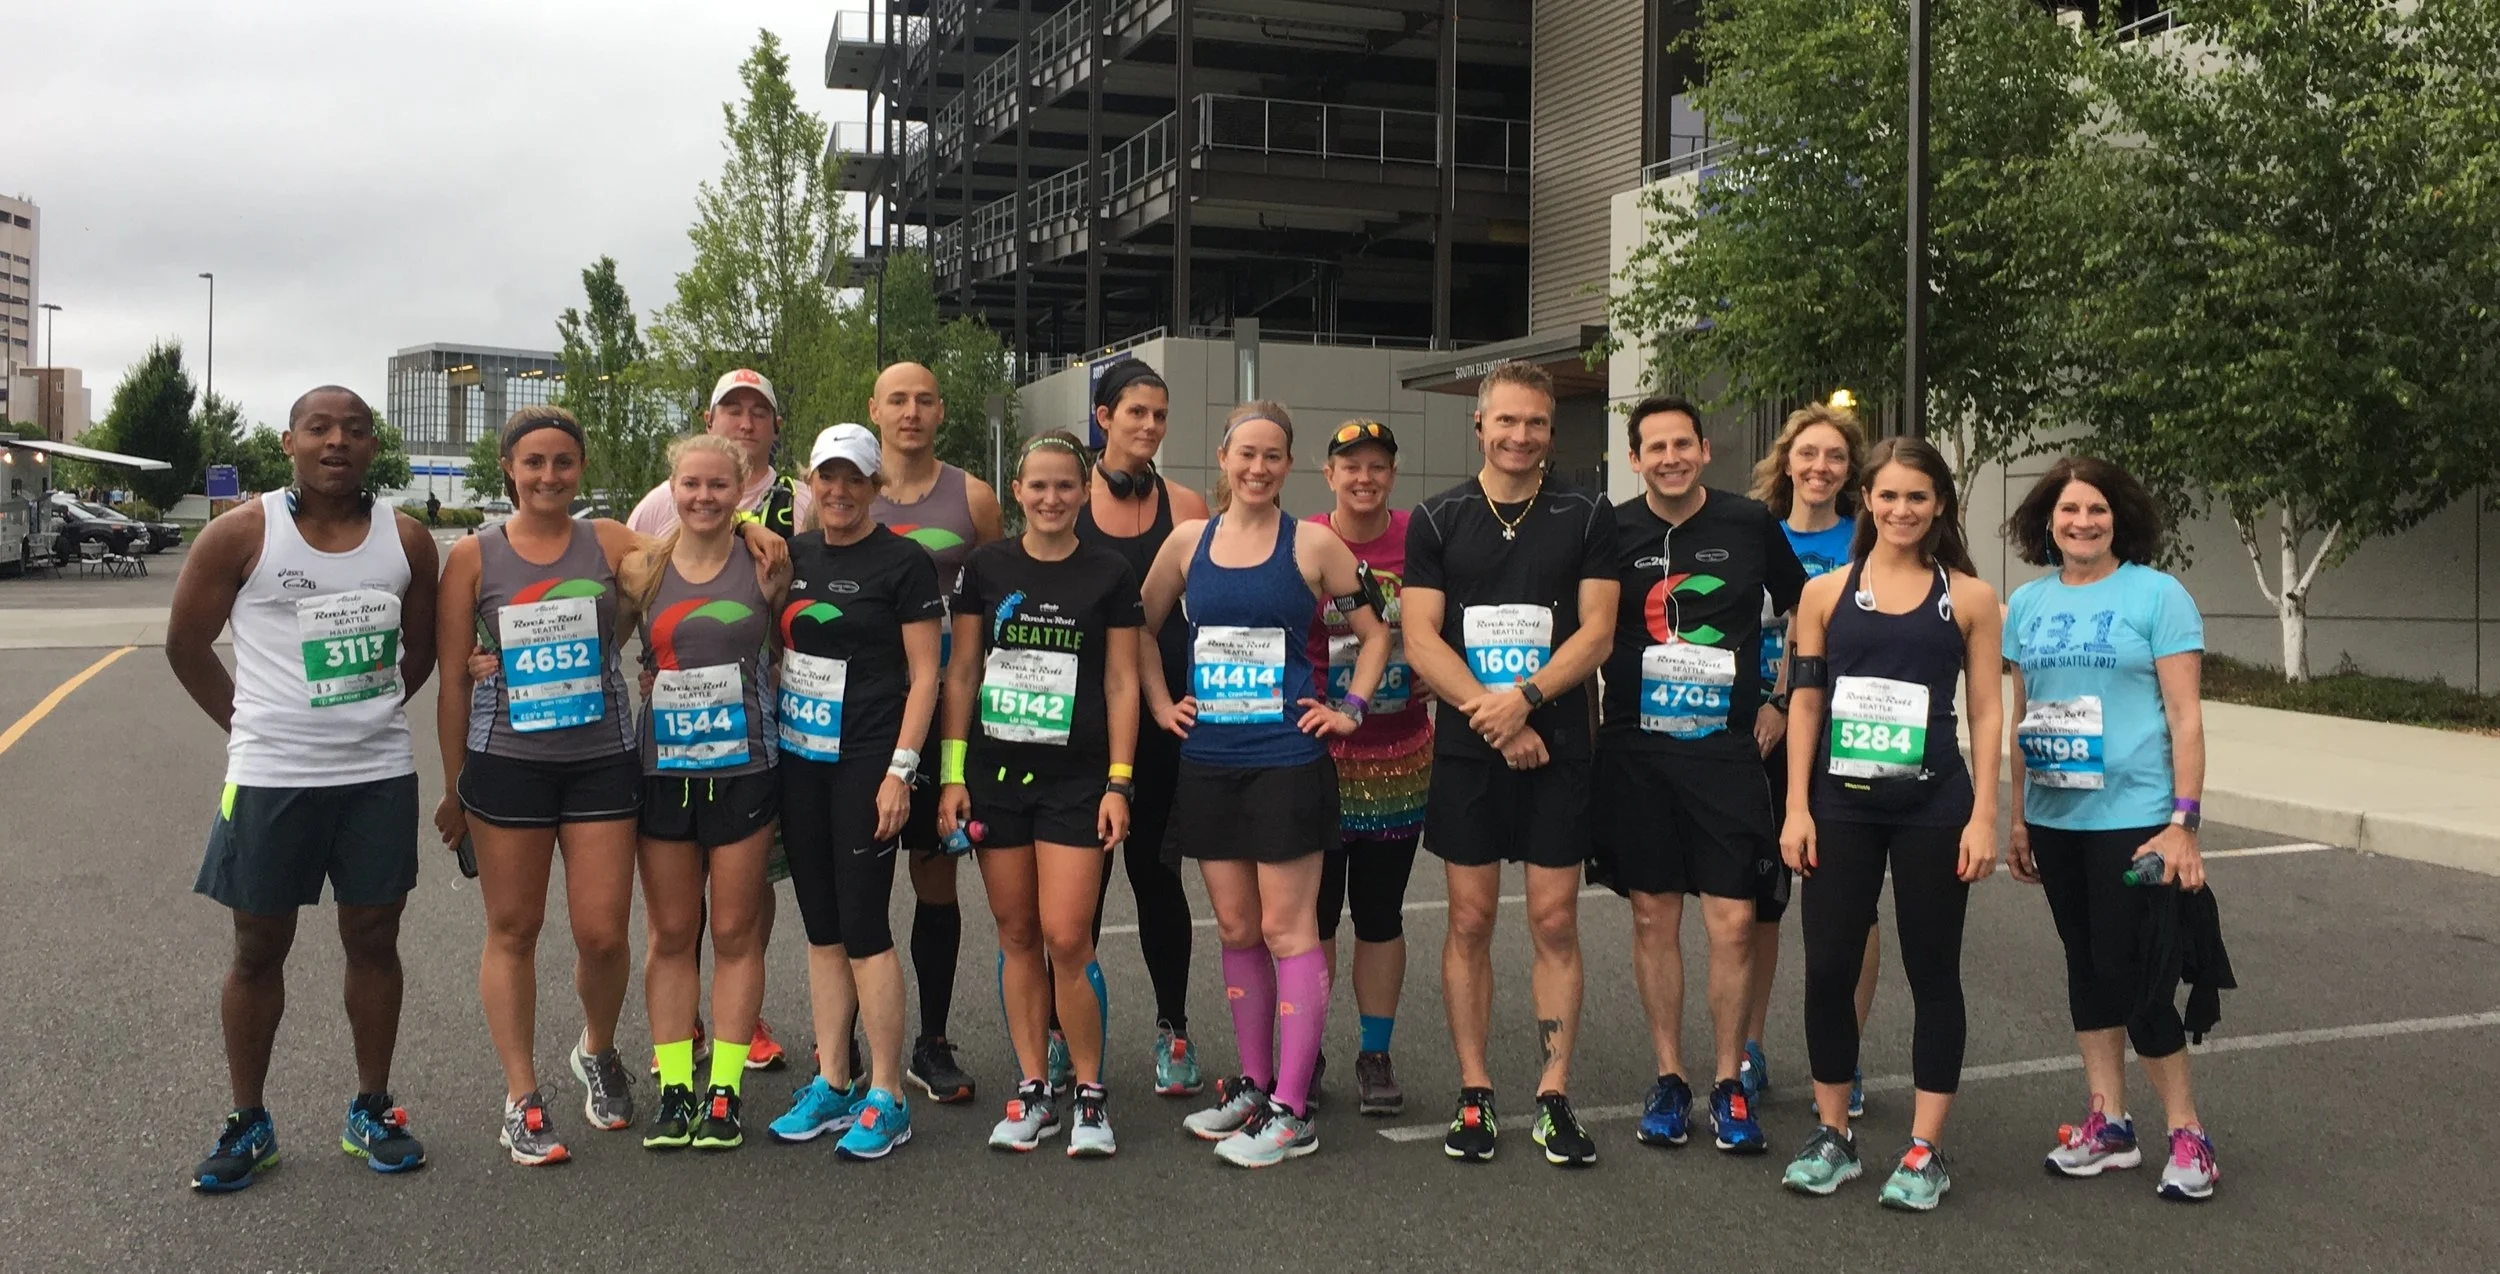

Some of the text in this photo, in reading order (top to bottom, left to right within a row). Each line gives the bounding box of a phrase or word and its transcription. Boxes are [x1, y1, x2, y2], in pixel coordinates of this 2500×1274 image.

[1455, 364, 1475, 379] SOUTH
[314, 609, 347, 620] Rock
[360, 604, 387, 614] Roll
[334, 615, 370, 626] SEATTLE
[513, 618, 545, 629] Rock
[557, 613, 582, 622] Roll
[1020, 613, 1045, 623] Rock
[1054, 616, 1076, 626] Roll
[1476, 620, 1503, 628] Rock
[1517, 619, 1541, 628] Roll
[330, 625, 377, 637] MARATHON
[532, 624, 566, 635] SEATTLE
[533, 634, 578, 644] MARATHON
[1006, 624, 1084, 650] SEATTLE
[1207, 639, 1234, 648] Rock
[1246, 640, 1271, 648] Roll
[325, 634, 385, 667] 3113
[1223, 649, 1254, 657] SEATTLE
[515, 642, 591, 674] 4652
[1476, 648, 1540, 674] 1606
[1656, 655, 1686, 665] Rock
[1698, 658, 1721, 669] Roll
[2040, 656, 2056, 669] RUN
[2059, 655, 2090, 668] SEATTLE
[2094, 656, 2117, 669] 2017
[808, 670, 831, 681] Roll
[1000, 662, 1027, 671] Rock
[1038, 666, 1063, 676] Roll
[1673, 666, 1705, 675] SEATTLE
[791, 676, 814, 687] SEATTLE
[1015, 673, 1045, 682] SEATTLE
[1200, 665, 1276, 689] 14414
[1671, 675, 1715, 684] MARATHON
[661, 684, 691, 692] Rock
[703, 681, 727, 690] Roll
[1008, 682, 1050, 692] MARATHON
[678, 692, 712, 700] SEATTLE
[1651, 684, 1721, 708] 4705
[1846, 692, 1871, 701] Rock
[1885, 696, 1912, 706] Roll
[679, 700, 723, 708] MARATHON
[781, 692, 831, 726] 4646
[989, 689, 1065, 720] 15142
[1859, 703, 1892, 712] SEATTLE
[665, 708, 733, 736] 1544
[1852, 712, 1897, 722] MARATHON
[1840, 721, 1912, 754] 5284
[2026, 737, 2090, 762] 11198
